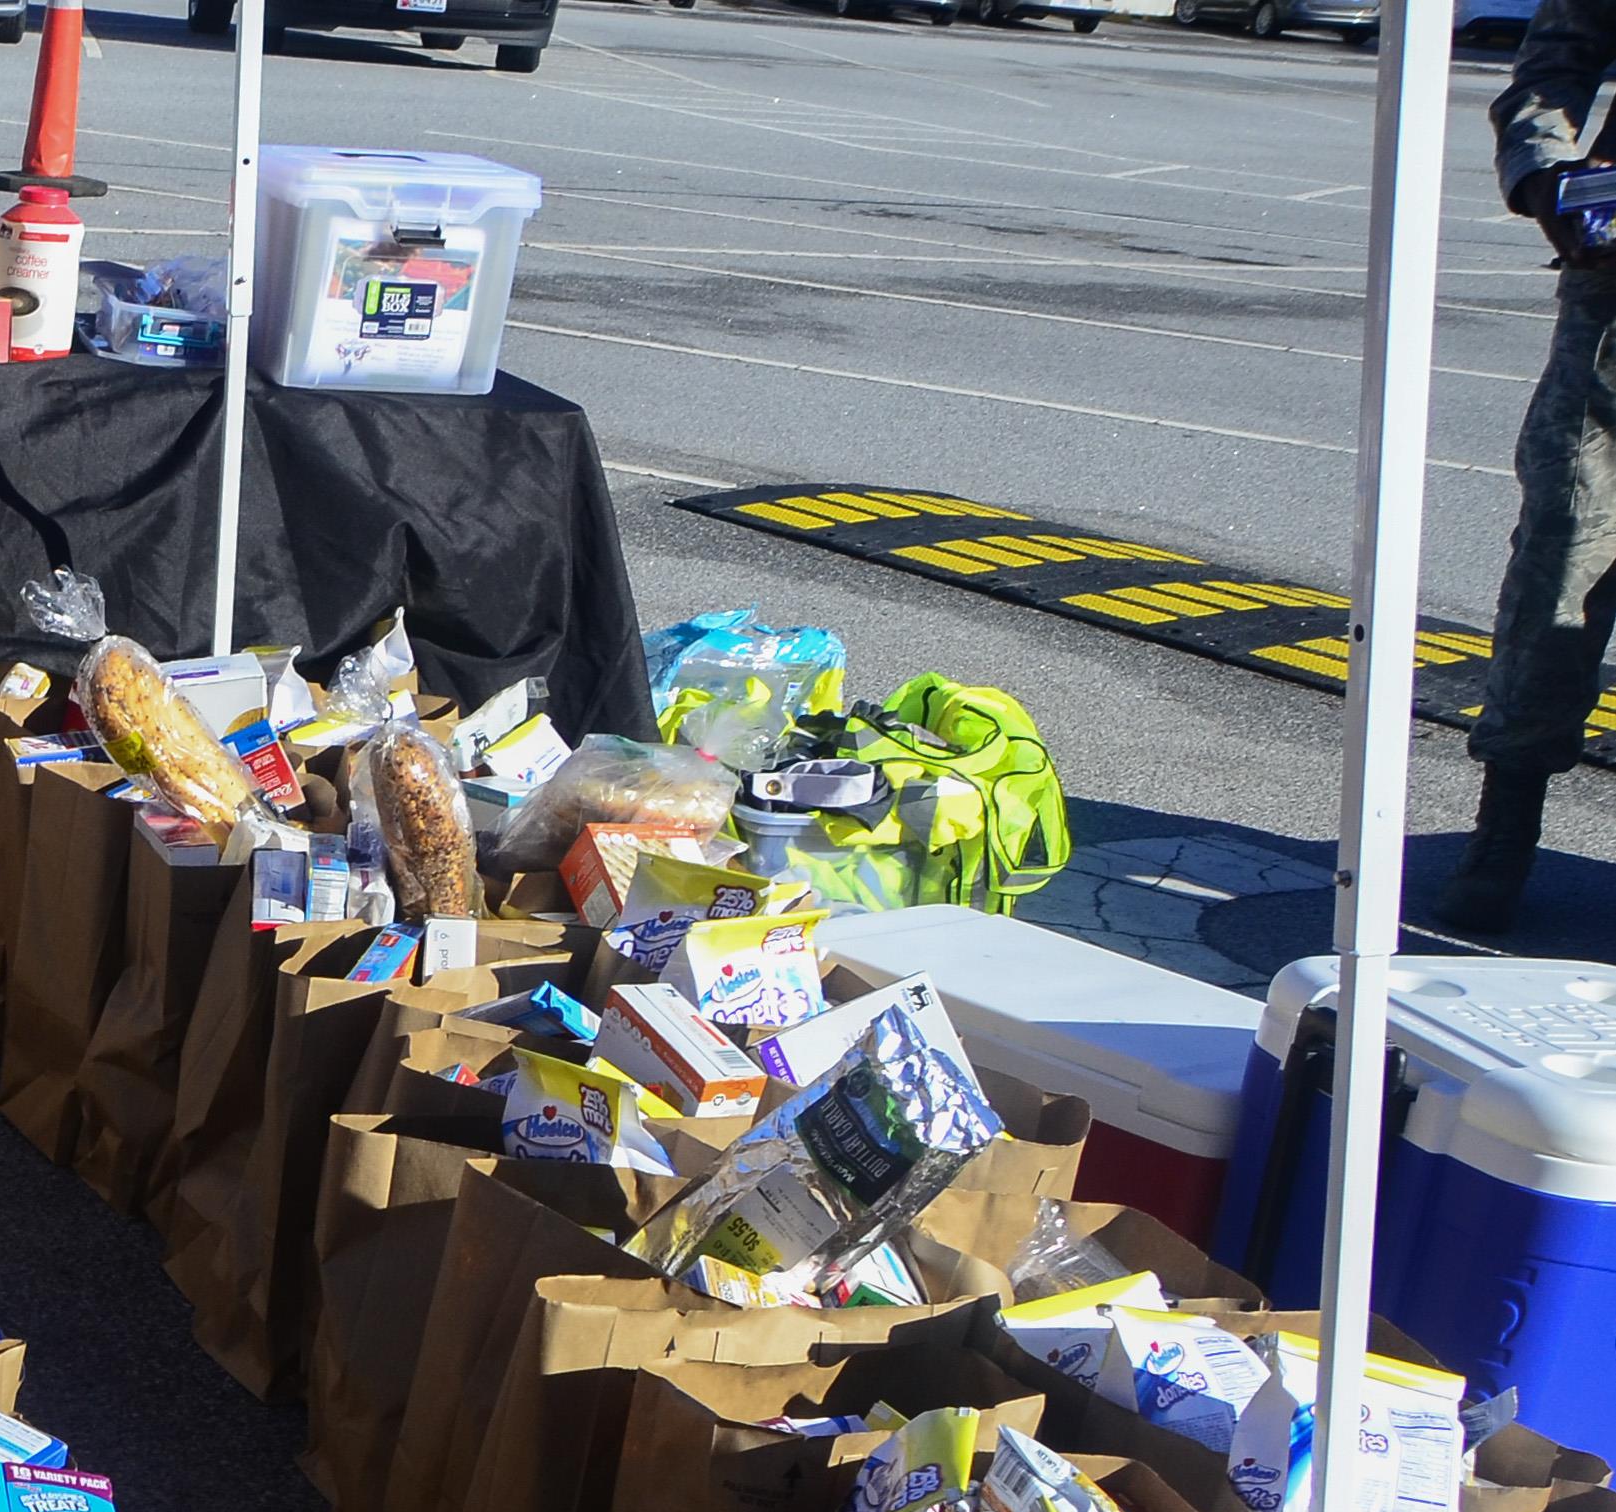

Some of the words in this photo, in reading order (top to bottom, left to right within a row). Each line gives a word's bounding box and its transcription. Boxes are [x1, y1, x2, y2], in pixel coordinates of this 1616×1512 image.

[16, 254, 48, 268] coffee
[6, 265, 50, 280] creamer
[381, 301, 411, 313] BOX
[32, 1469, 78, 1485] VARIETY
[79, 1477, 109, 1491] PACK
